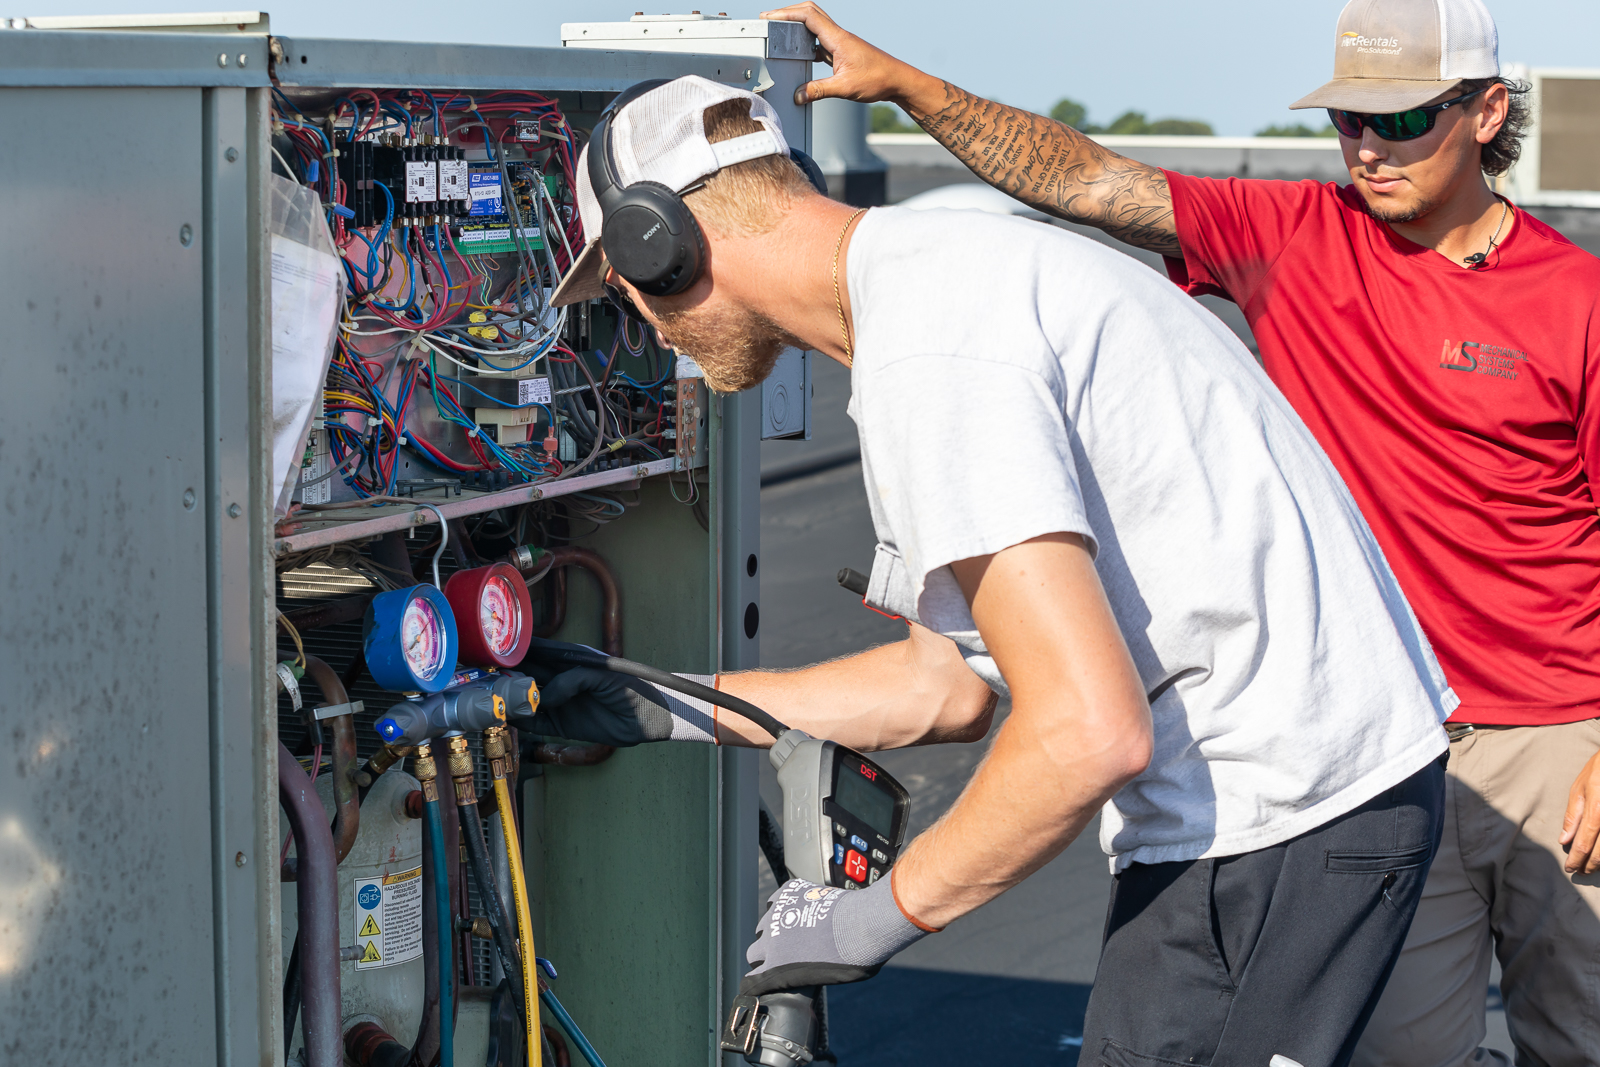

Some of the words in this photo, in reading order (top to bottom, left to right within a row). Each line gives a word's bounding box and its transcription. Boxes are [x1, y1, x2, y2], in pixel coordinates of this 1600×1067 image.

[1004, 122, 1013, 137] AND
[988, 134, 998, 146] FOR
[994, 137, 1007, 151] WHO
[1051, 140, 1061, 153] THE
[1002, 143, 1014, 161] shall
[1008, 143, 1024, 165] SAYING
[1020, 140, 1044, 181] Lord
[1057, 148, 1070, 167] THEN
[1042, 154, 1056, 172] VOICE
[1038, 171, 1047, 181] OF
[1044, 170, 1059, 193] HEARD
[1031, 181, 1042, 193] THE
[1480, 344, 1529, 362] MECHANICAL
[1478, 354, 1515, 370] SYSTEMS
[1476, 365, 1518, 380] COMPANY
[860, 764, 878, 781] DST
[770, 878, 806, 938] MaxiFlex
